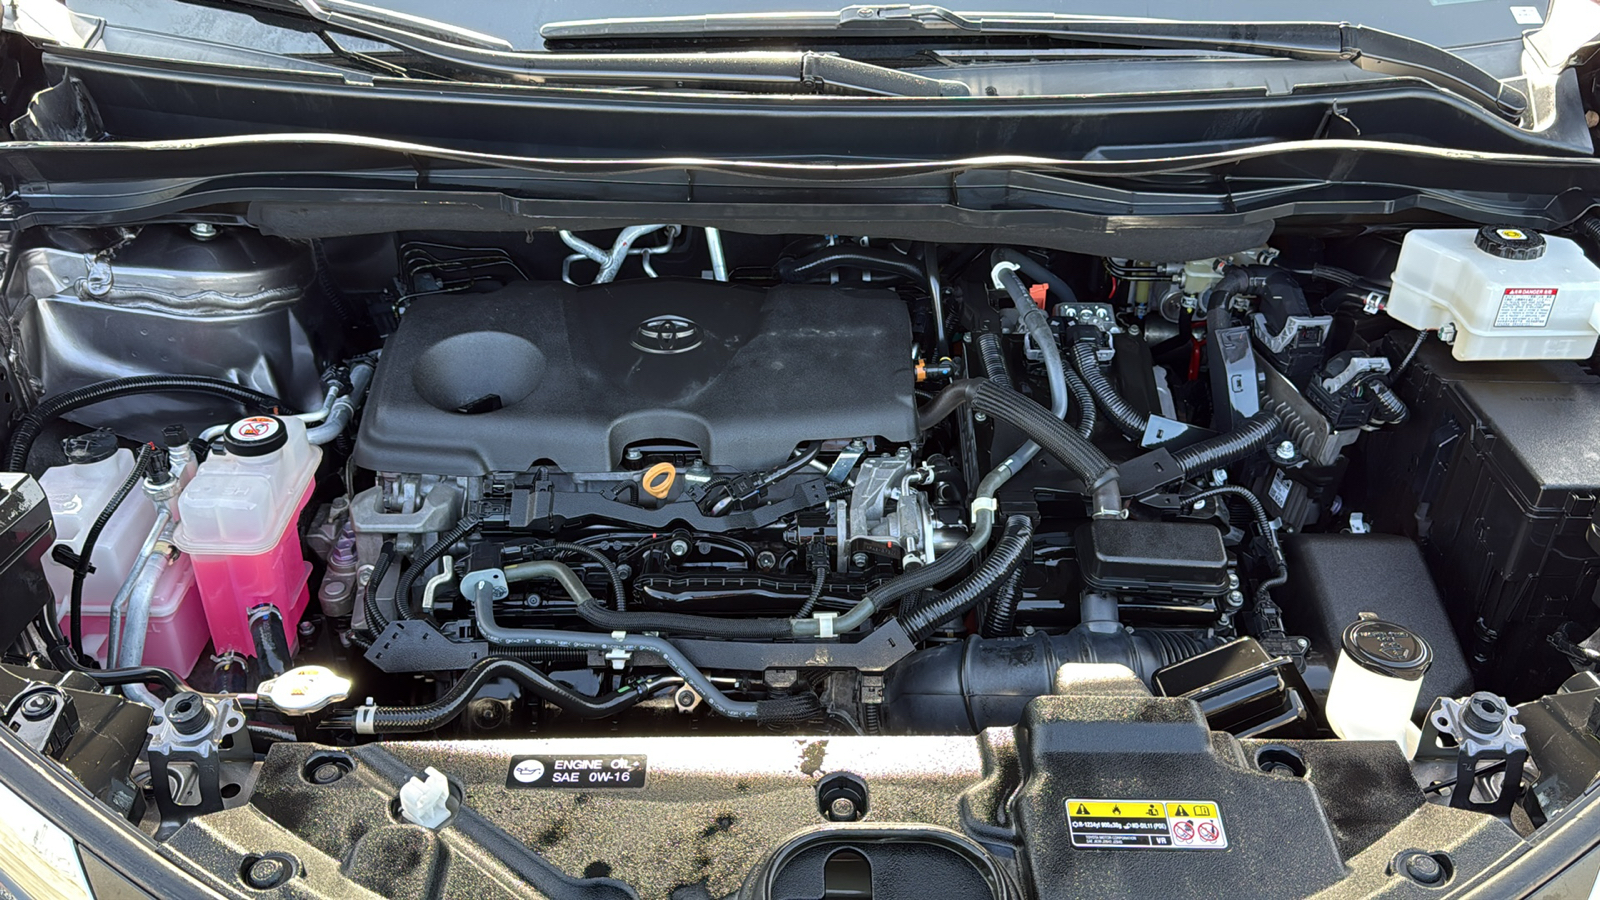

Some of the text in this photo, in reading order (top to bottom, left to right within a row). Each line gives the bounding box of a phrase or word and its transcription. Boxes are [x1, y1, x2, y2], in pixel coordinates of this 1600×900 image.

[554, 758, 632, 770] ENGINE OIL
[552, 771, 630, 783] SAE 0W-16
